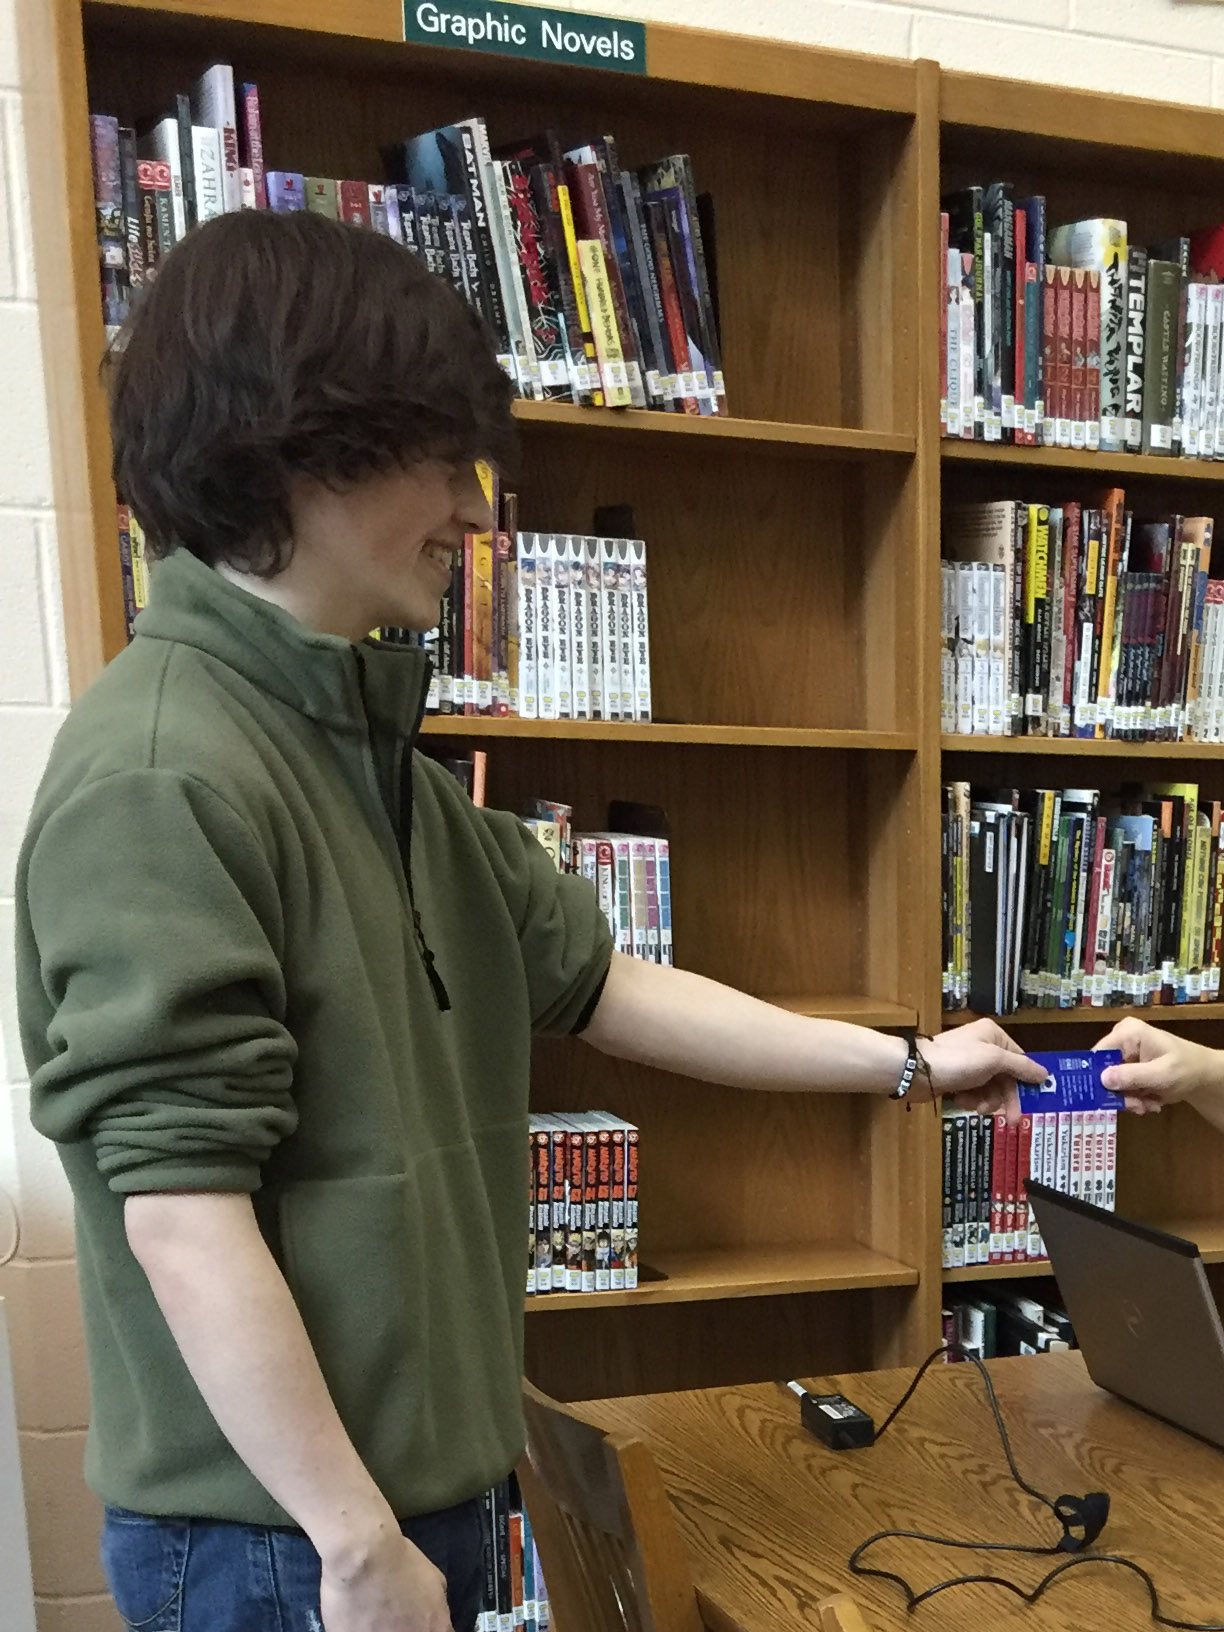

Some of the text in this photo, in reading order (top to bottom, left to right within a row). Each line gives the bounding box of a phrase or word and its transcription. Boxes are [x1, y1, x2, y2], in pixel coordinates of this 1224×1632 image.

[416, 3, 635, 61] Graphic Novels
[200, 148, 219, 219] ZAHRA
[462, 132, 487, 228] BATMAN
[127, 216, 139, 243] Life
[975, 237, 983, 256] WAR
[1003, 199, 1014, 260] MANGAMAN
[974, 258, 983, 304] JOURNAL
[601, 314, 615, 346] DEMONS
[949, 328, 958, 356] THE
[1126, 274, 1145, 414] TEMPLAR
[1160, 309, 1171, 406] CASTLE WAITING
[1034, 524, 1049, 599] WATCHMEN
[1069, 548, 1078, 596] SUPERMAN
[524, 588, 534, 661] DRAGON EYE
[540, 587, 550, 659] DRAGON EYE
[557, 590, 567, 662] DRAGON EYE
[574, 591, 584, 664] DRAGON EYE
[589, 591, 599, 665] DRAGON EYE
[607, 591, 617, 663] DRAGON EYE
[620, 593, 630, 665] DRAGON EYE
[636, 592, 646, 665] DRAGON EYE
[1199, 839, 1208, 873] NOTHING
[1033, 1131, 1042, 1173] Yukarism
[1045, 1131, 1054, 1173] Yukarism
[1060, 1129, 1069, 1171] Yukarism
[1072, 1133, 1082, 1173] Yurara
[1084, 1133, 1093, 1172] Yurara
[1096, 1132, 1104, 1171] Yurara
[1107, 1131, 1116, 1171] Yurara
